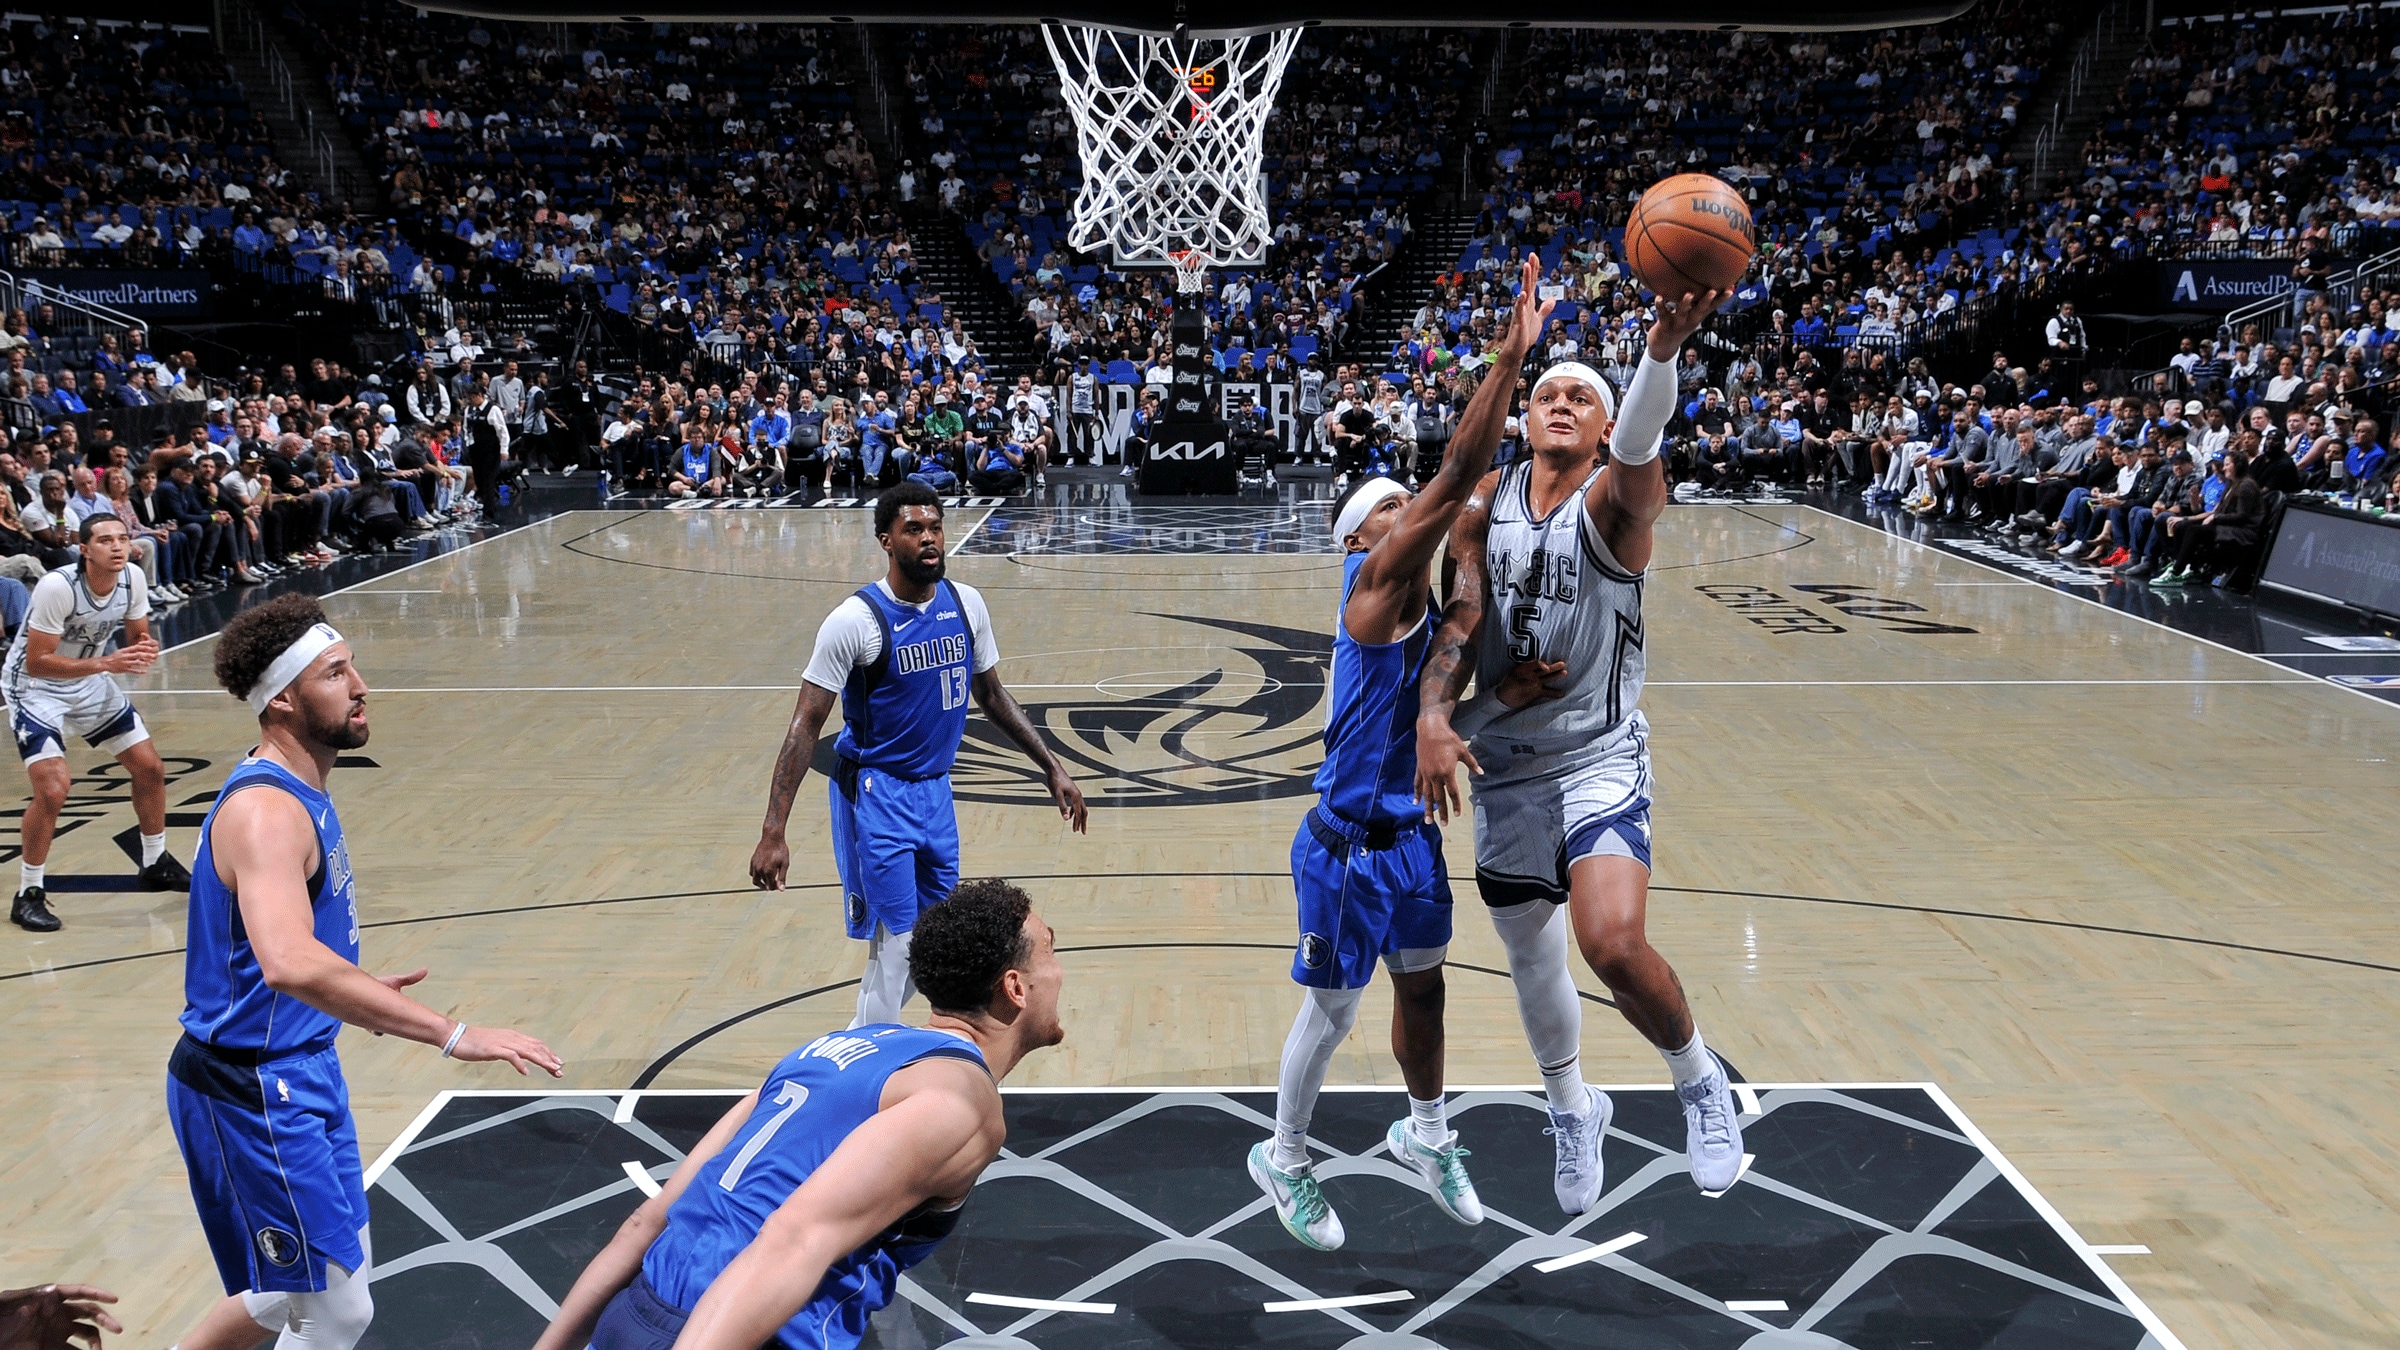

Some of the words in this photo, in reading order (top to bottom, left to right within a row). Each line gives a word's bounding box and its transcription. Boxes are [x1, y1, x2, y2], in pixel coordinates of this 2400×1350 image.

[55, 283, 198, 304] AssuredPartners
[936, 610, 958, 621] chime
[1694, 584, 1848, 634] CENTER
[896, 633, 967, 675] DALLAS
[1508, 604, 1542, 664] 5
[939, 666, 967, 711] 13
[798, 1035, 880, 1072] POWELL
[718, 1079, 810, 1192] 7
